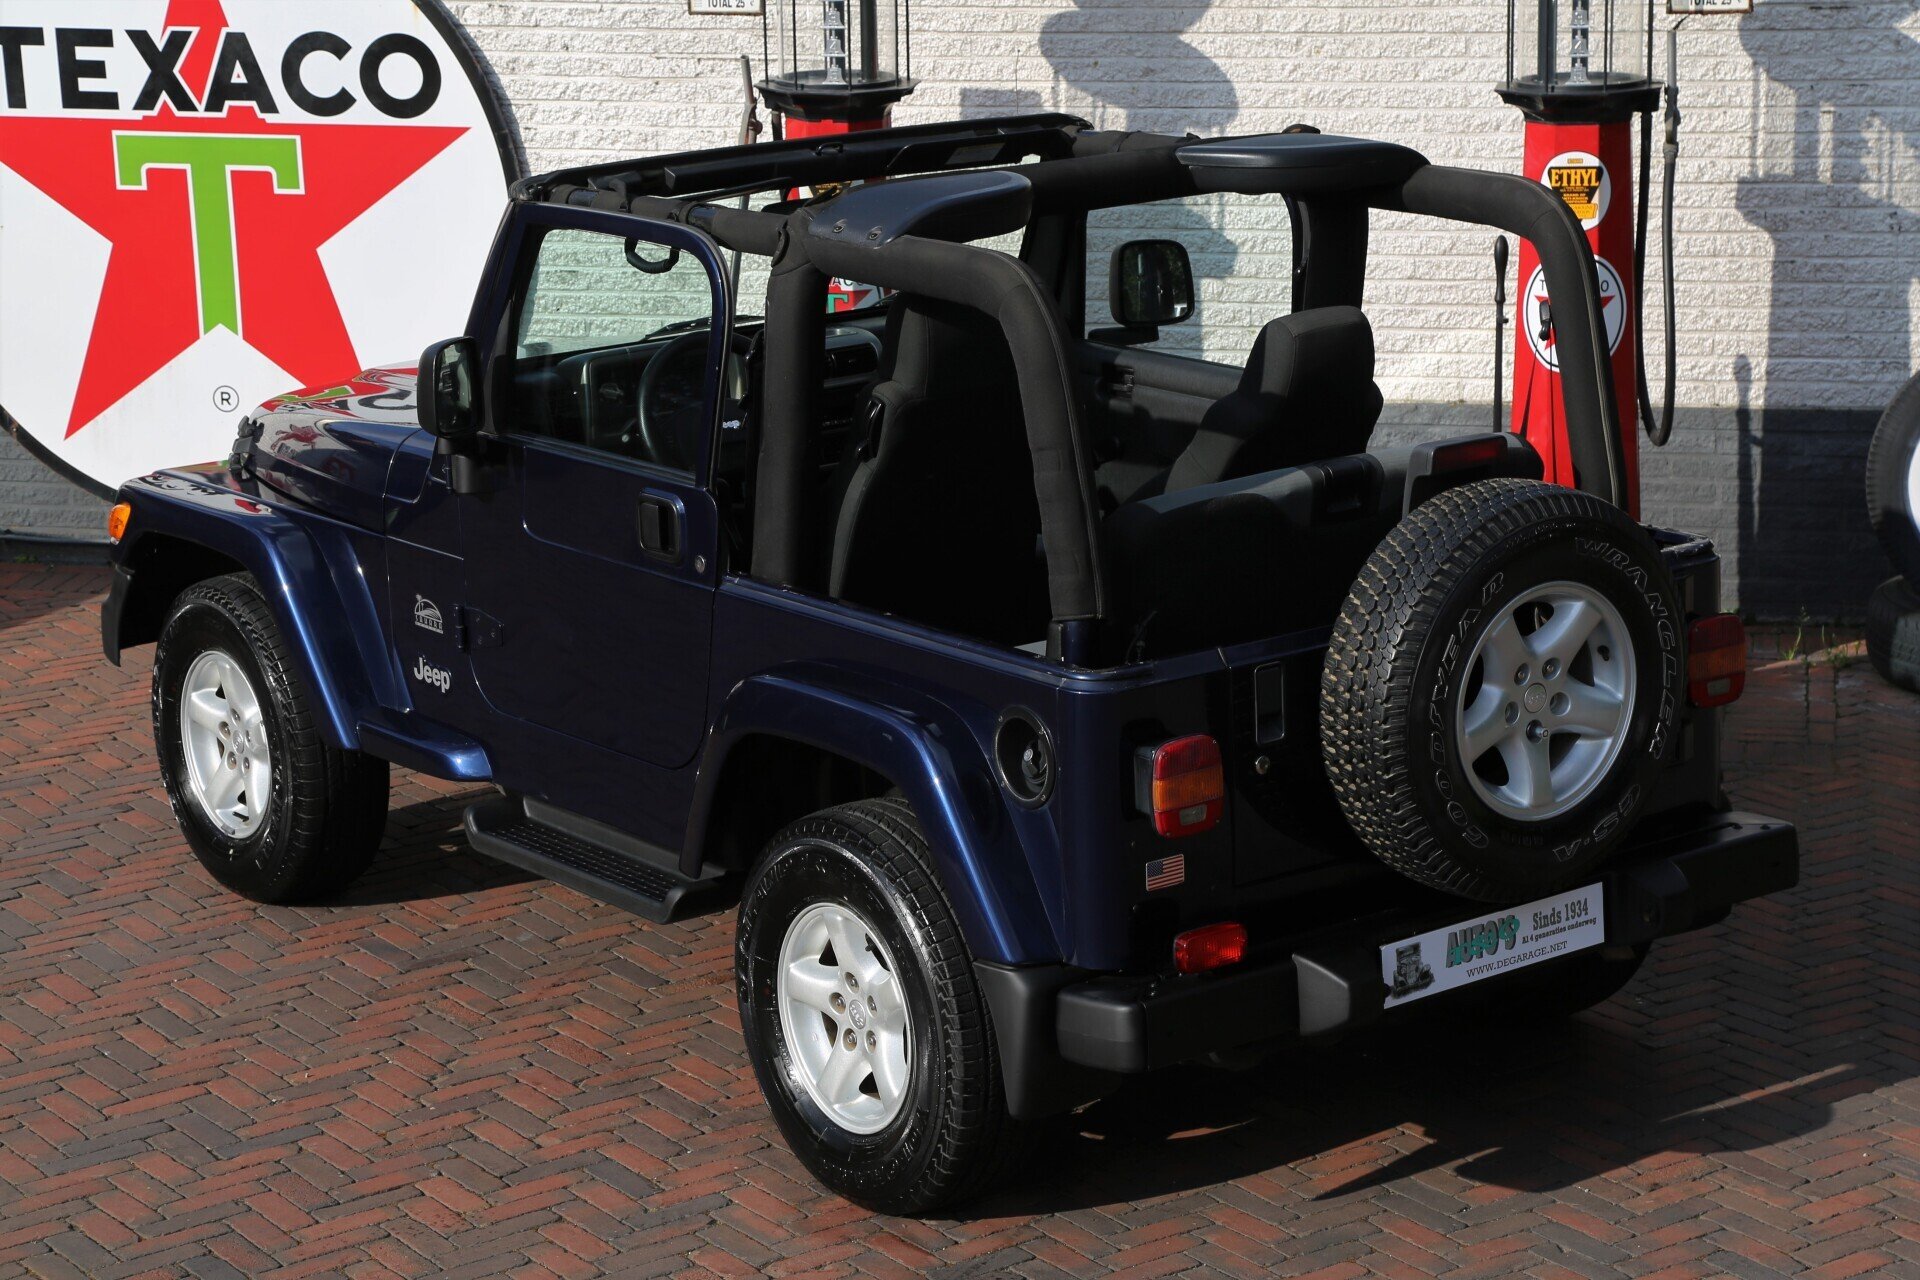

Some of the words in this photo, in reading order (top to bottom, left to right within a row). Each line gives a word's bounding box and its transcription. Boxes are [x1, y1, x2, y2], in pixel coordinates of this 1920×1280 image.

[0, 26, 442, 118] TEXACO
[1550, 168, 1600, 187] ETHYL
[114, 132, 303, 336] T
[1575, 536, 1677, 760] WRANGLER
[413, 656, 451, 693] Jeep
[1430, 571, 1505, 849] GOODYEAR
[1532, 907, 1562, 931] Sinds
[1565, 897, 1589, 921] 1934
[1534, 926, 1567, 942] generaties
[1567, 917, 1597, 933] onderweg
[1445, 914, 1518, 968] AUTO'S
[1466, 941, 1568, 977] WWW.DEGARAGE.NET
